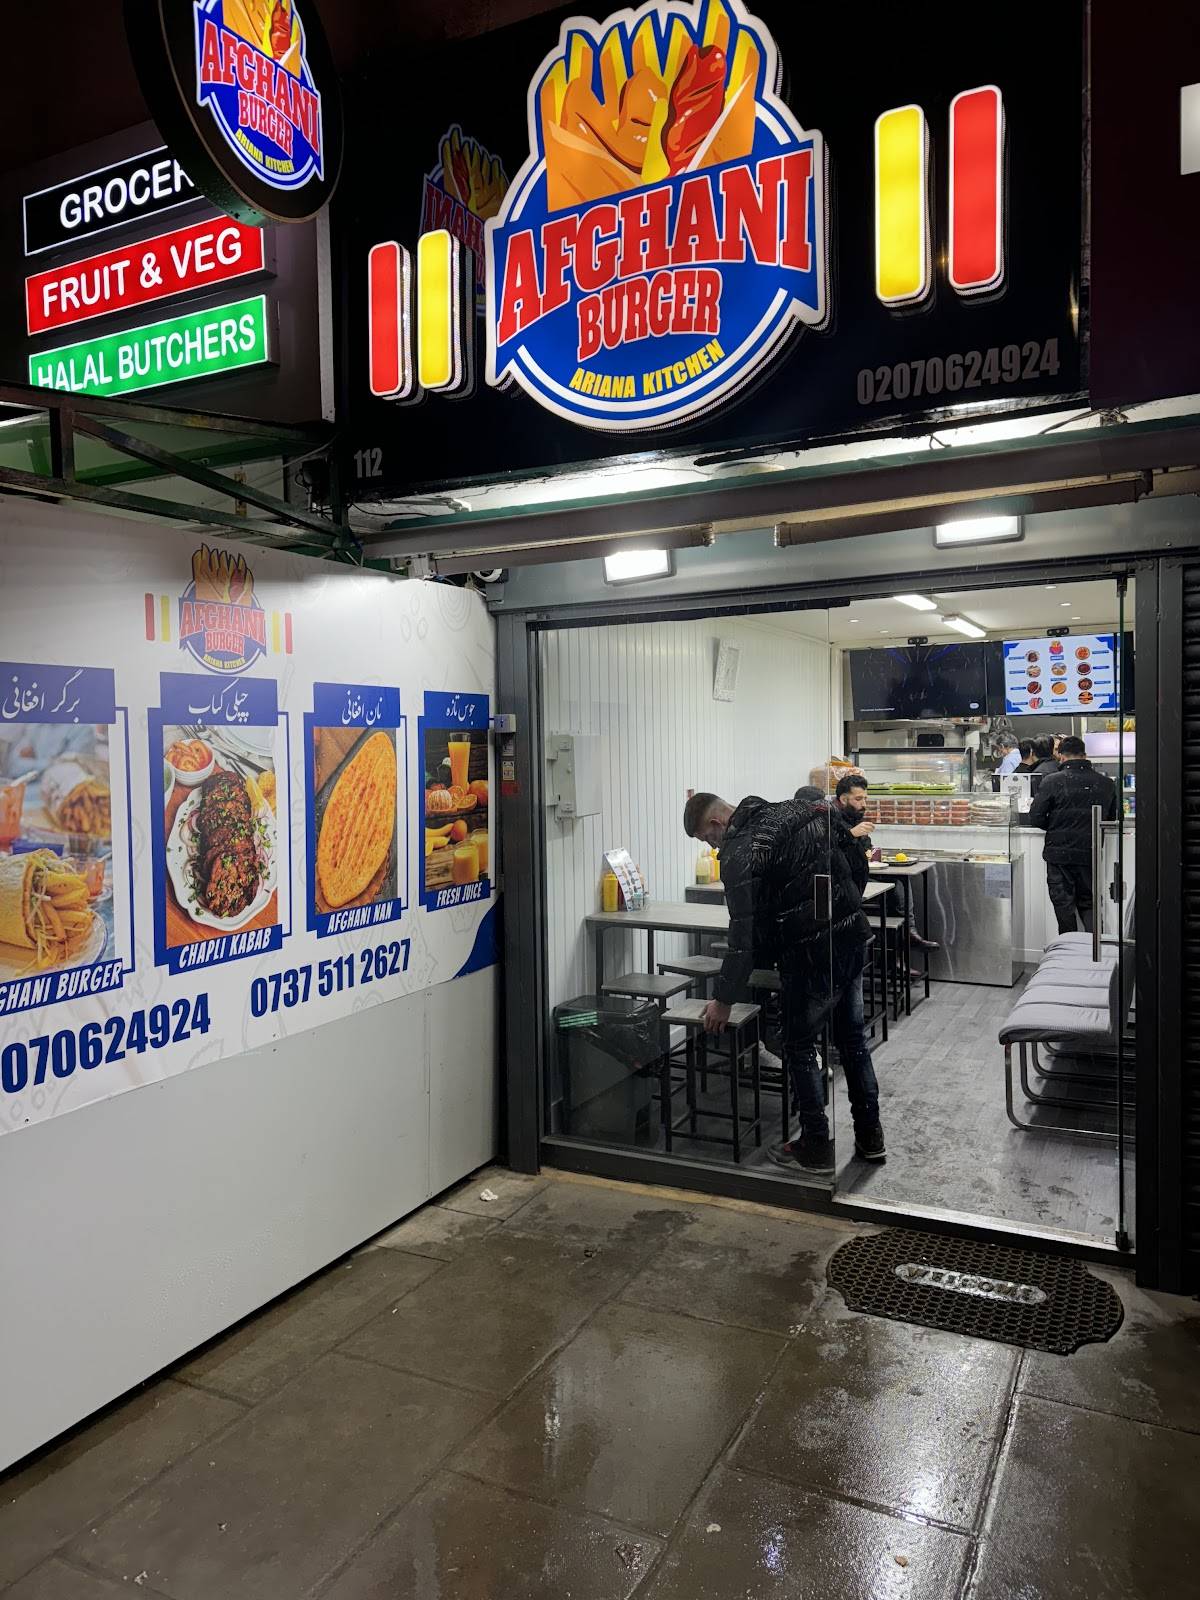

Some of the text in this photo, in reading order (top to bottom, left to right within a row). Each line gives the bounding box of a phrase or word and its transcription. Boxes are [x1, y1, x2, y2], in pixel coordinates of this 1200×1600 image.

[201, 19, 319, 155] AFGHANI
[235, 128, 294, 173] ARIANA KITCHEN
[237, 90, 293, 158] BURGER
[42, 233, 242, 318] FRUIT & VEG
[498, 148, 813, 347] AFGHANI
[577, 267, 721, 362] BURGER
[38, 314, 256, 391] HALAL BUTCHERS
[569, 339, 724, 399] ARIANA KITCHEN
[857, 337, 1061, 405] 02070624924
[354, 448, 383, 478] 112
[180, 602, 265, 646] AFGHANI
[205, 631, 245, 657] BURGER
[326, 901, 394, 933] AFGHANI NAN
[436, 881, 483, 906] FRESH JUICE
[56, 962, 123, 1000] BURGER
[178, 929, 273, 969] CHAPLI KABAB
[251, 939, 411, 1018] 0737 511 2627
[1, 992, 211, 1094] 070624924
